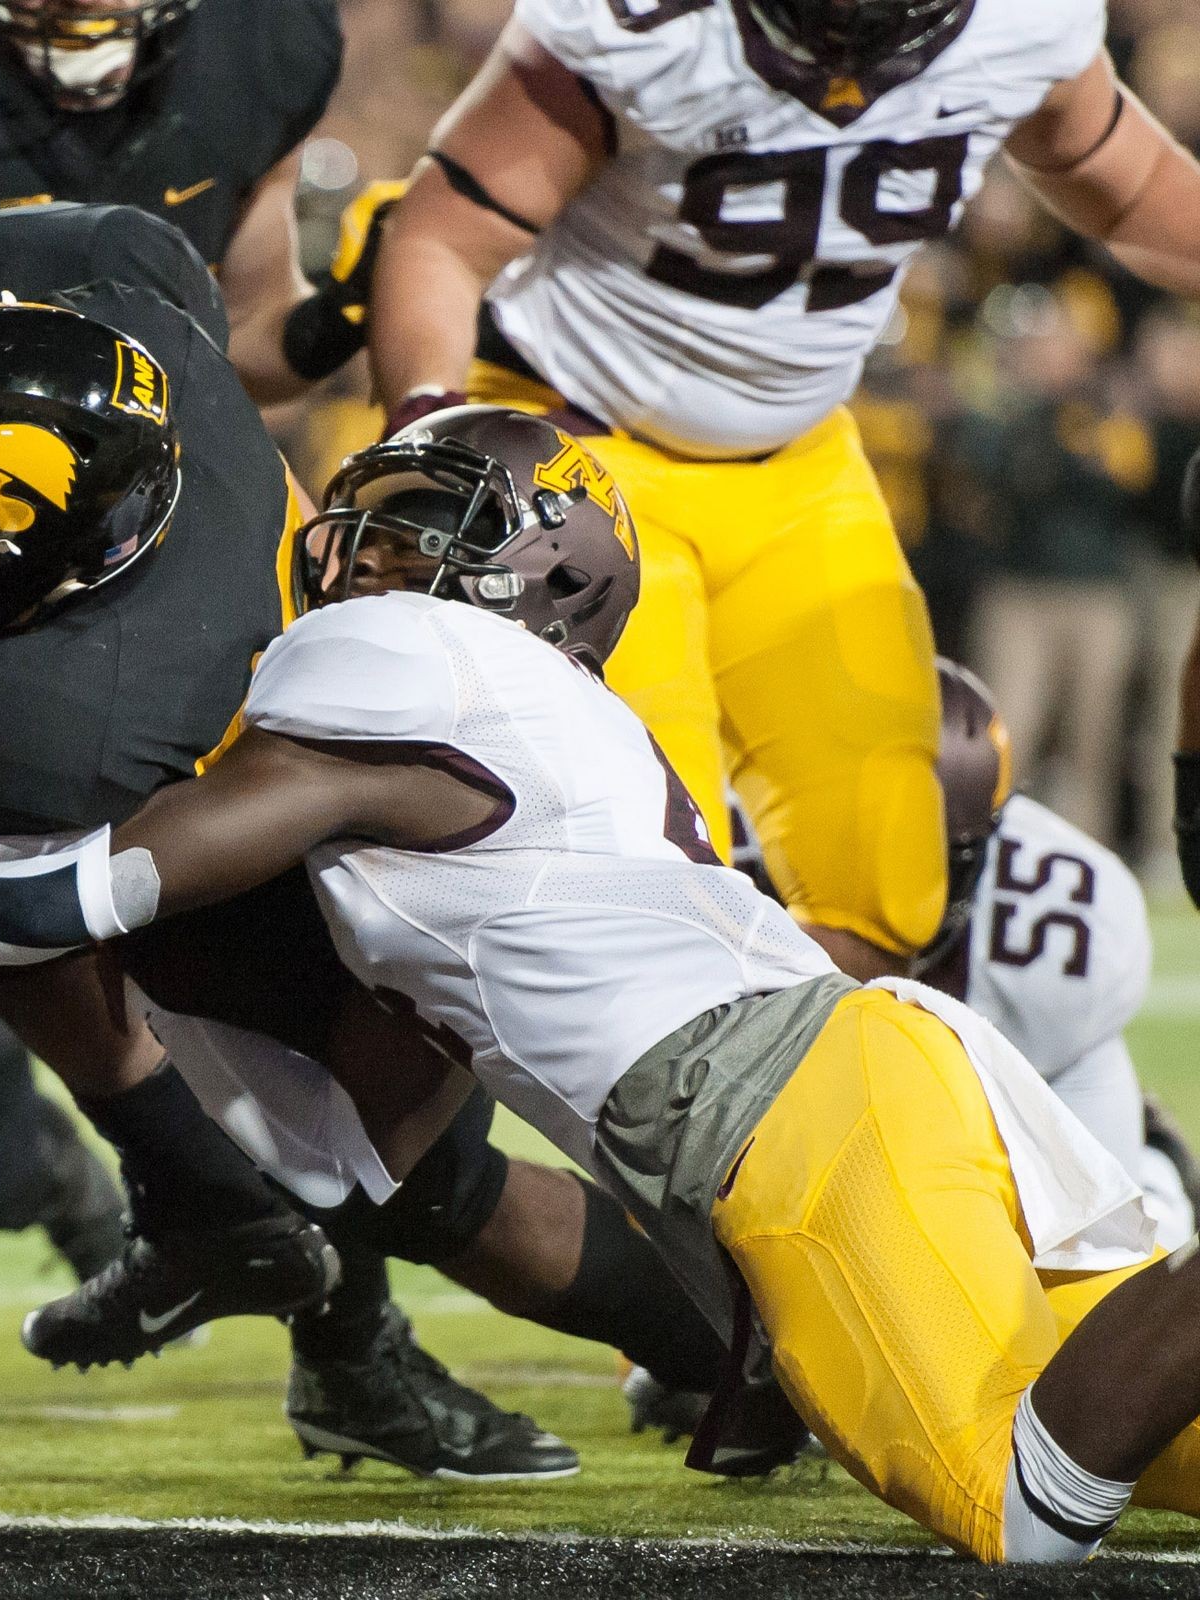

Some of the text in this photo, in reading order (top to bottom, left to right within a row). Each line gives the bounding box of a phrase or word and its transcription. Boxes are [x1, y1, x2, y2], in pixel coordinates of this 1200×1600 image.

[645, 133, 970, 313] 99
[131, 349, 156, 411] ANF
[990, 837, 1096, 979] 55
